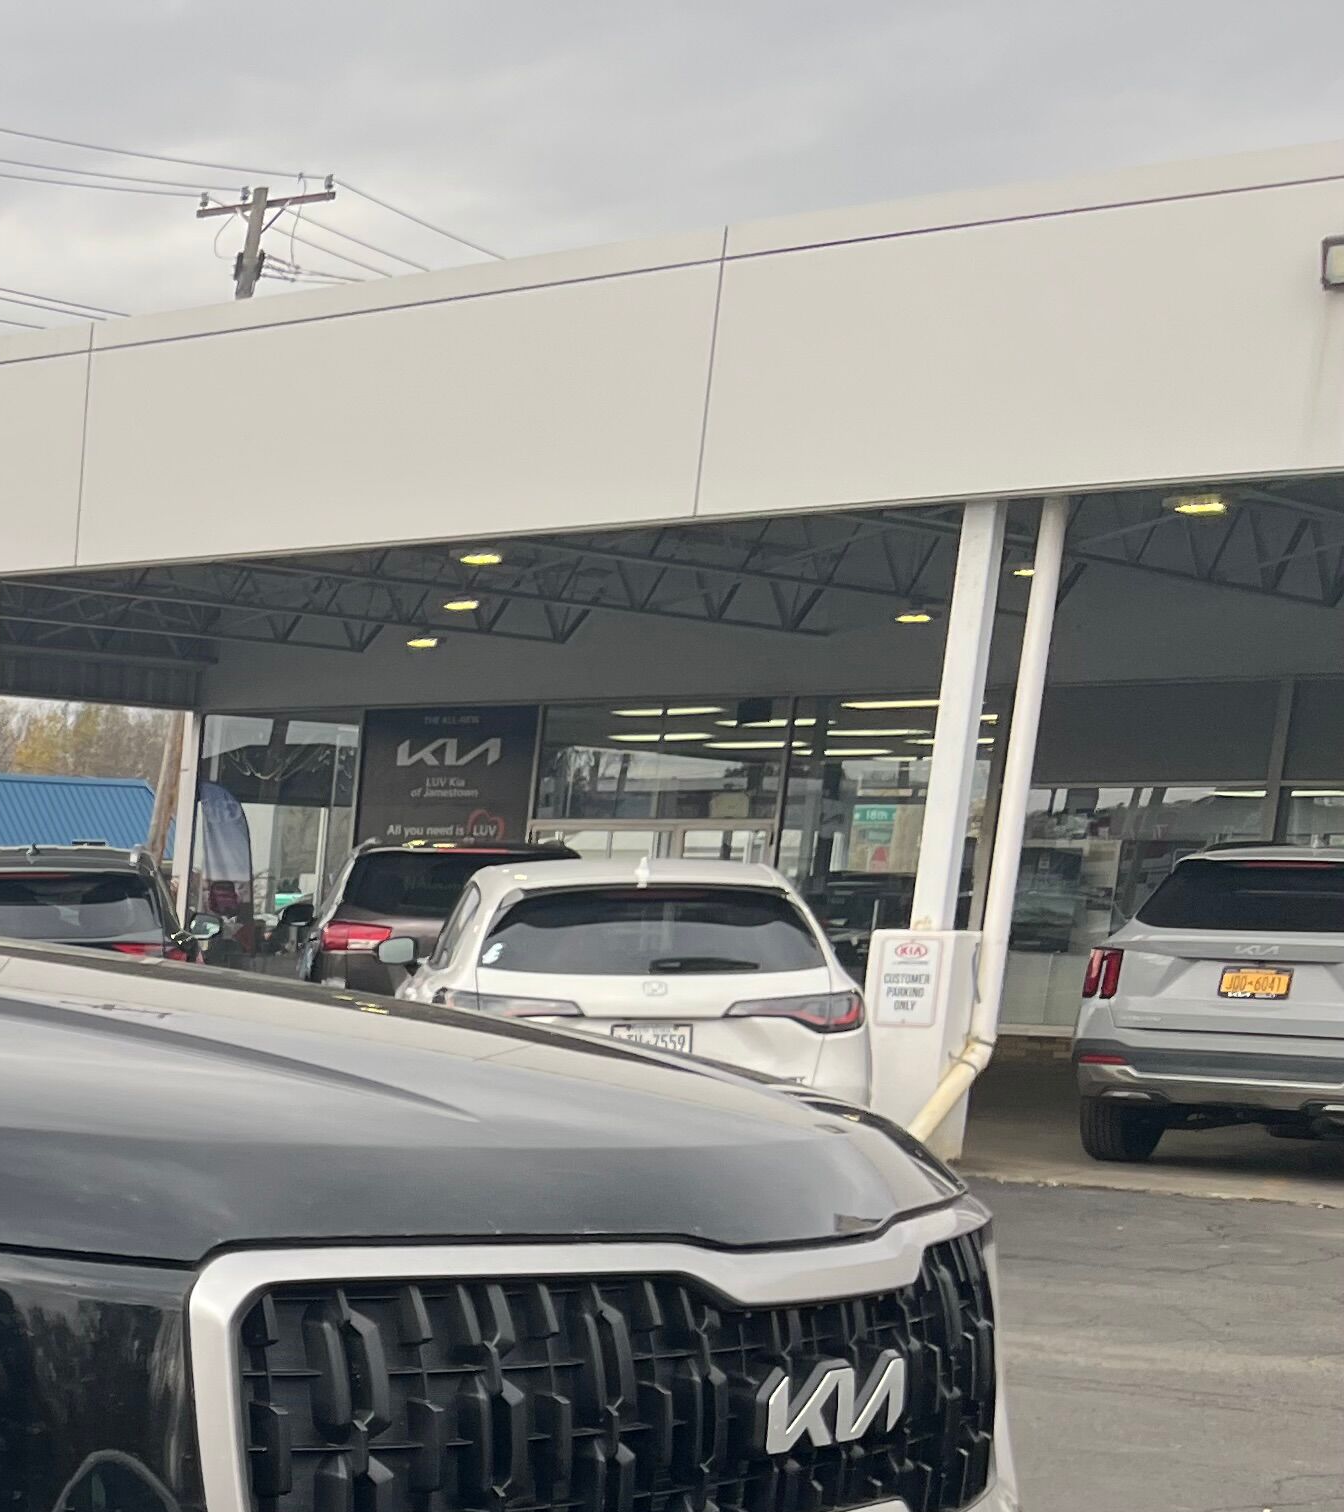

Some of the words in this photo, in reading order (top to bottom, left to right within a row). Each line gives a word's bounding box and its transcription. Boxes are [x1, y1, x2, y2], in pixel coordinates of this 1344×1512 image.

[396, 737, 502, 766] KIA
[425, 777, 447, 788] LUV
[386, 824, 402, 836] All
[404, 826, 424, 839] you
[426, 824, 453, 836] need
[455, 824, 465, 836] is
[472, 824, 498, 836] LUV
[883, 973, 930, 985] CUSTOMER
[886, 986, 925, 998] PARKING
[893, 999, 917, 1011] ONLY
[759, 1351, 906, 1456] KIA
